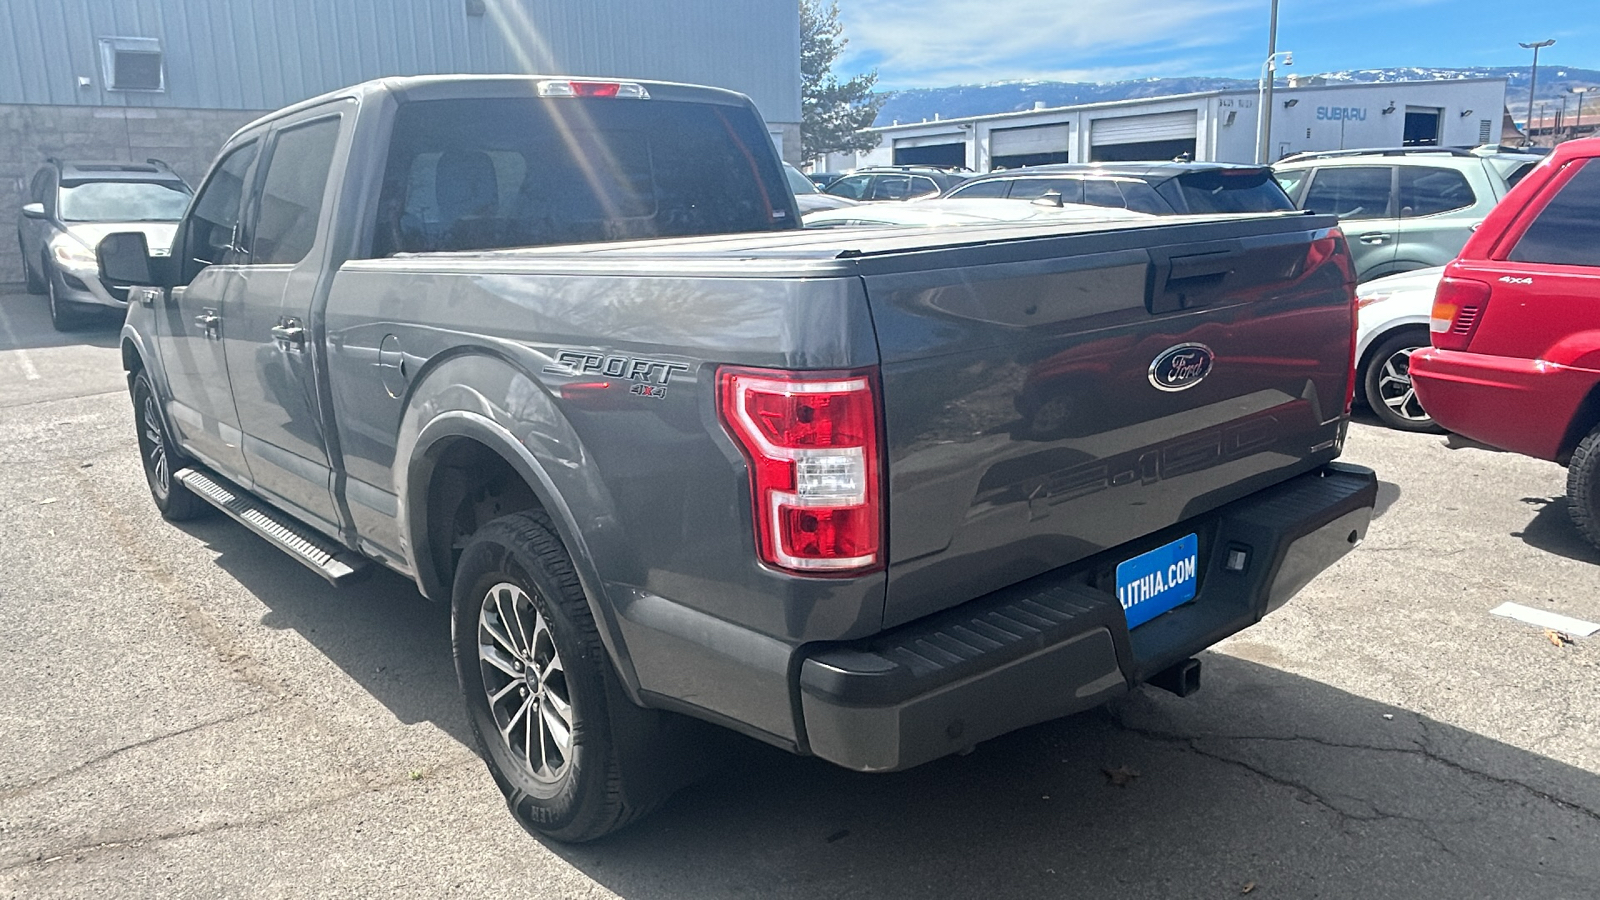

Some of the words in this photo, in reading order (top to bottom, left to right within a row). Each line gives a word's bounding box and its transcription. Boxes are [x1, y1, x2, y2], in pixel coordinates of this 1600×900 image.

[1316, 106, 1367, 121] SUBARU
[542, 349, 690, 385] SPORT
[1167, 353, 1204, 382] Ford
[1119, 554, 1196, 611] LITHIA.COM
